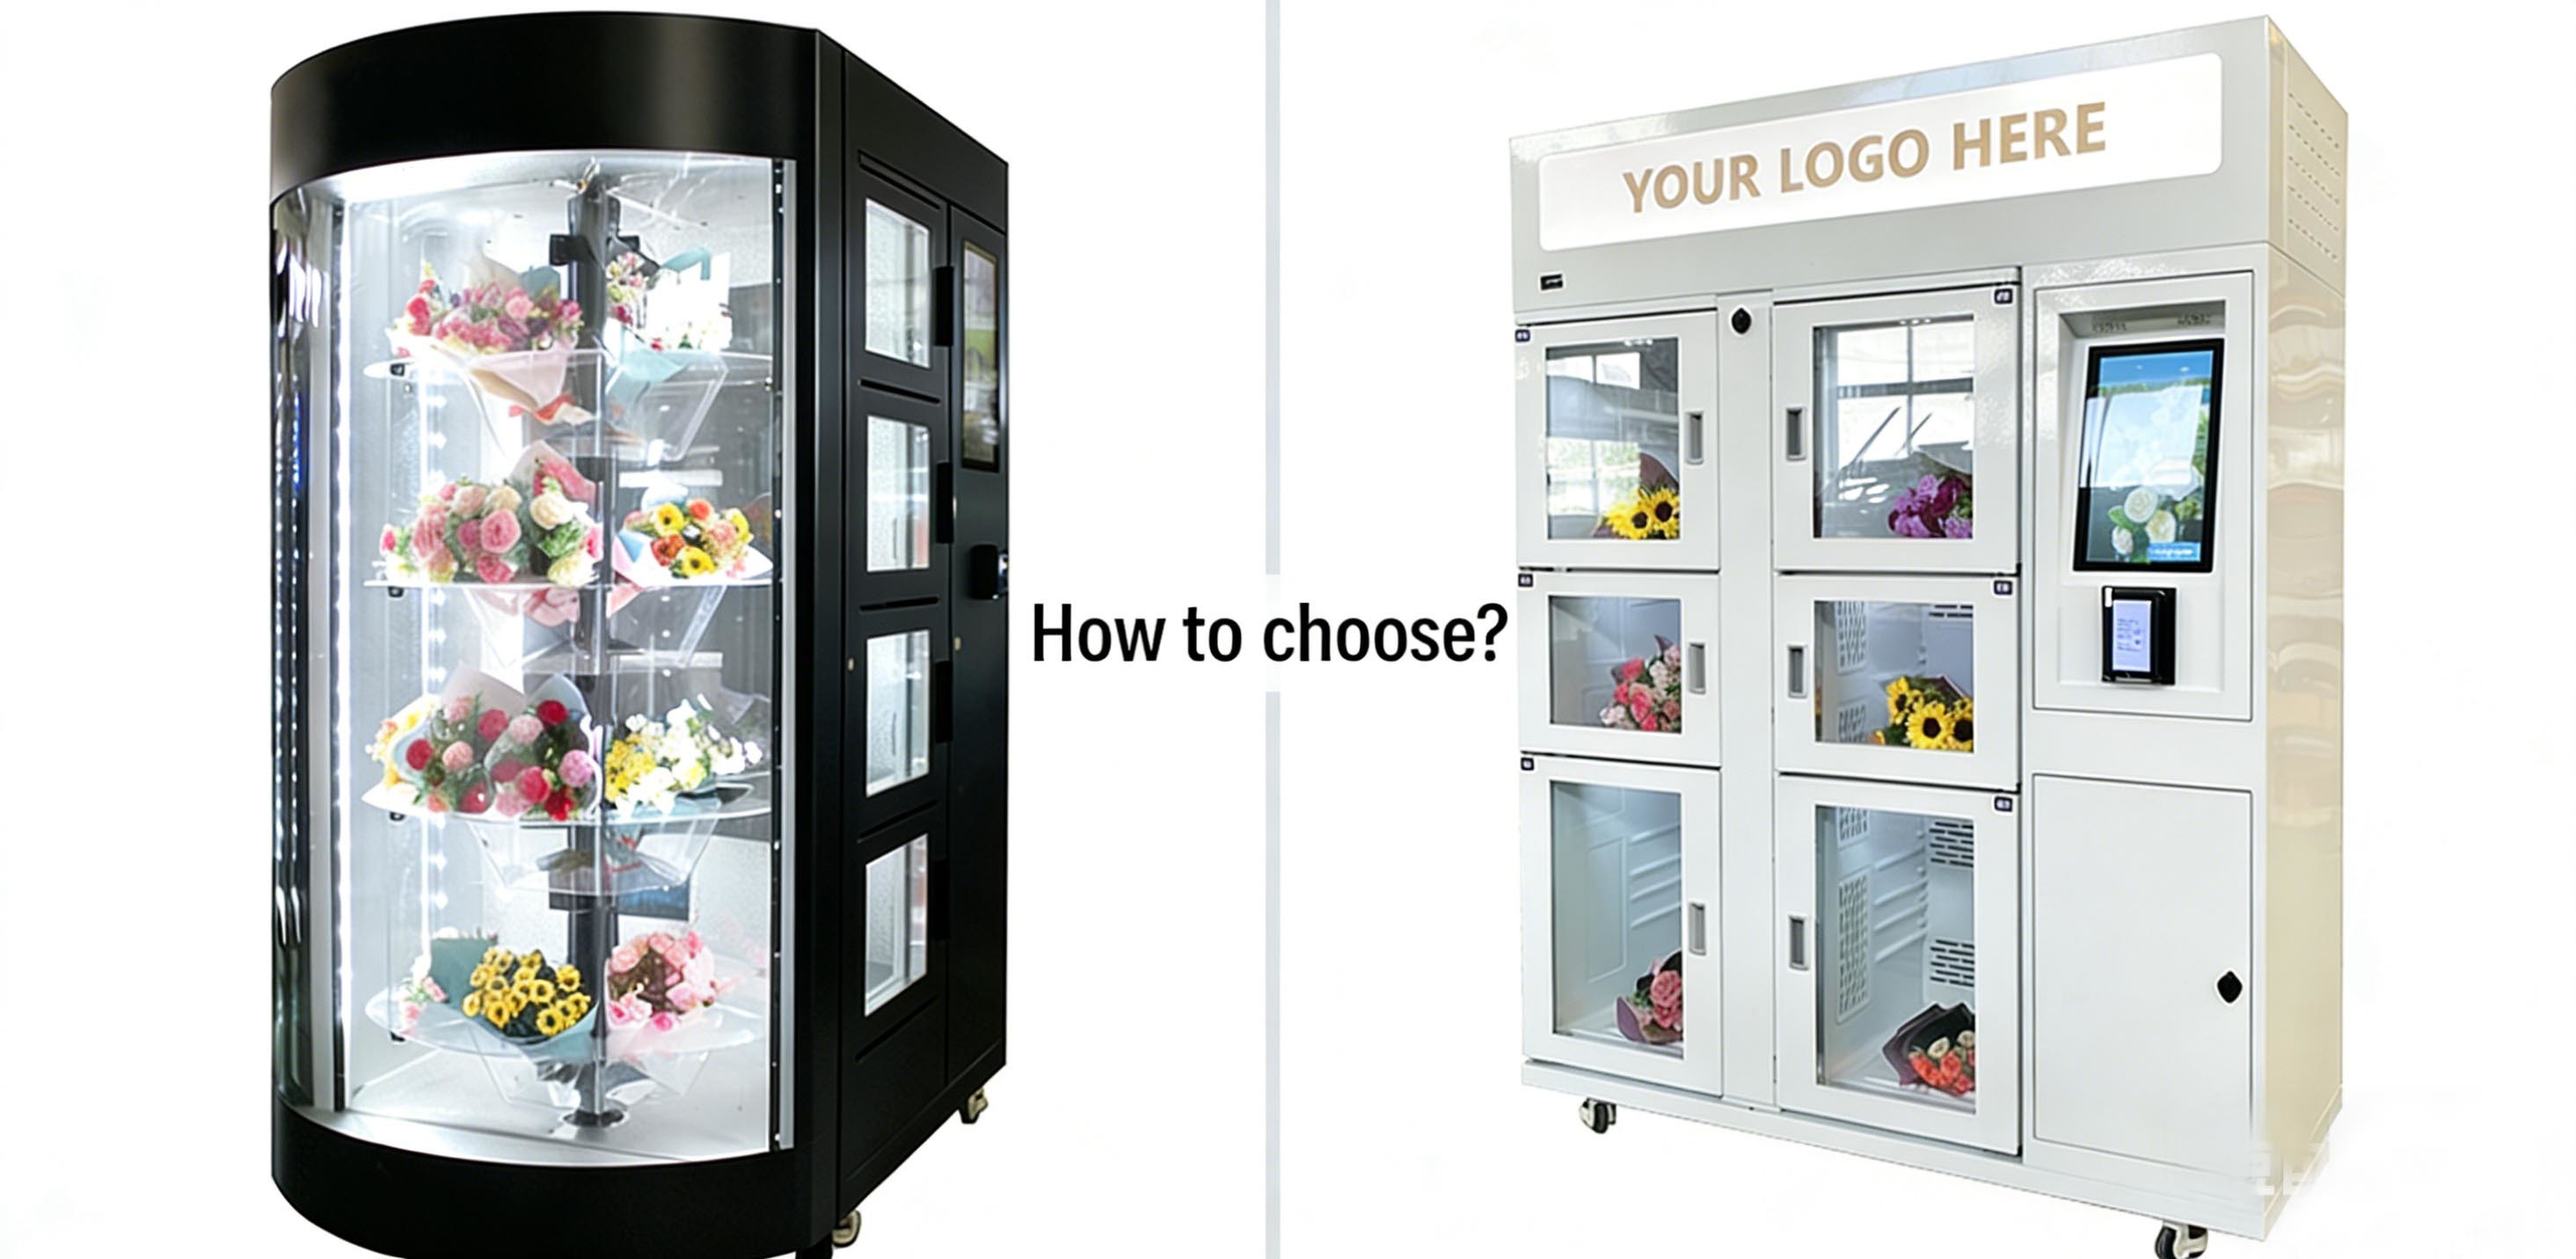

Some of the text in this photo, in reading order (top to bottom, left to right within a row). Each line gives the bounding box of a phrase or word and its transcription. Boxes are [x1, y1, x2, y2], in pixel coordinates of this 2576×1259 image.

[1623, 101, 2106, 214] YOUR LOGO HERE
